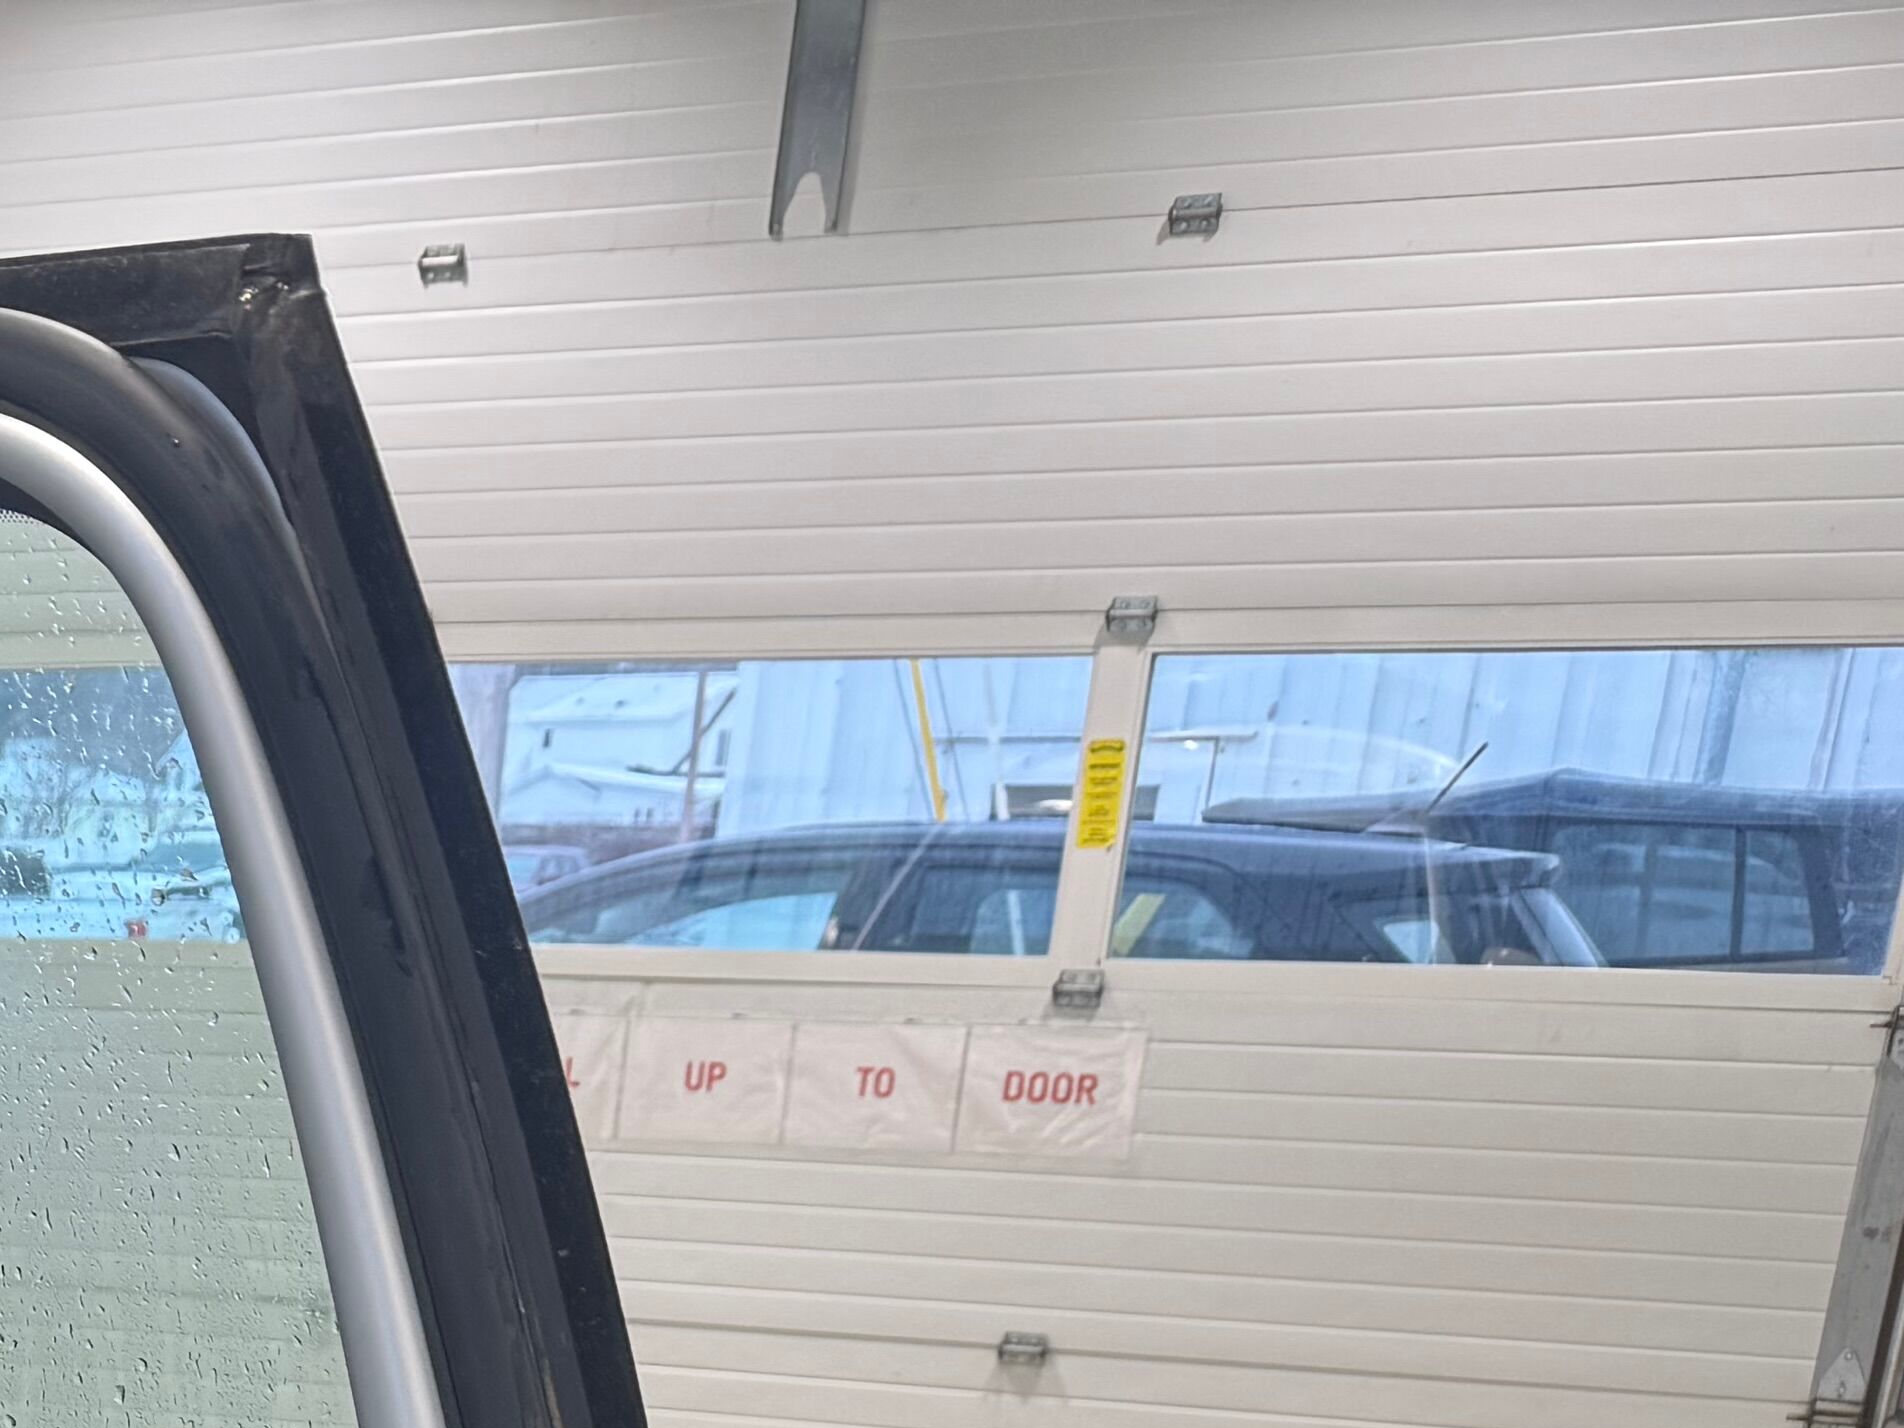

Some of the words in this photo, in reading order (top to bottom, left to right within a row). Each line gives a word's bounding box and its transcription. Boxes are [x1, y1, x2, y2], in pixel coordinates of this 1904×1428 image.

[684, 1060, 728, 1093] UP
[856, 1064, 897, 1099] TO
[1000, 1069, 1099, 1106] DOOR
